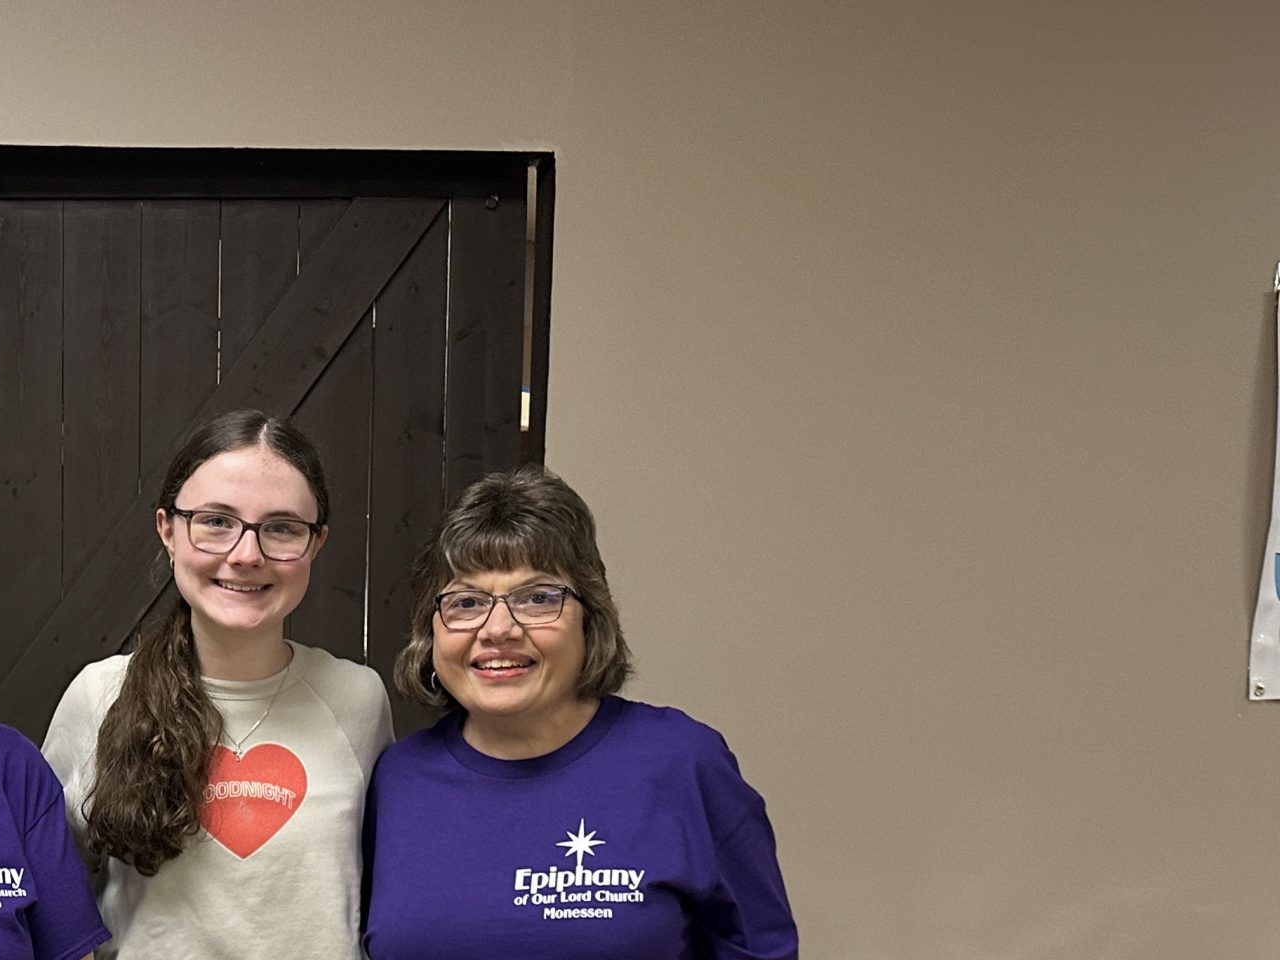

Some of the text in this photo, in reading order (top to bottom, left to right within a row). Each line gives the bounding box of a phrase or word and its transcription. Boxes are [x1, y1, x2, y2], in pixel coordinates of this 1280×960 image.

[202, 780, 296, 809] OODNIGHT
[514, 865, 645, 894] Epiphany
[513, 890, 644, 906] of Our Lord Church
[543, 907, 613, 920] Monessen
